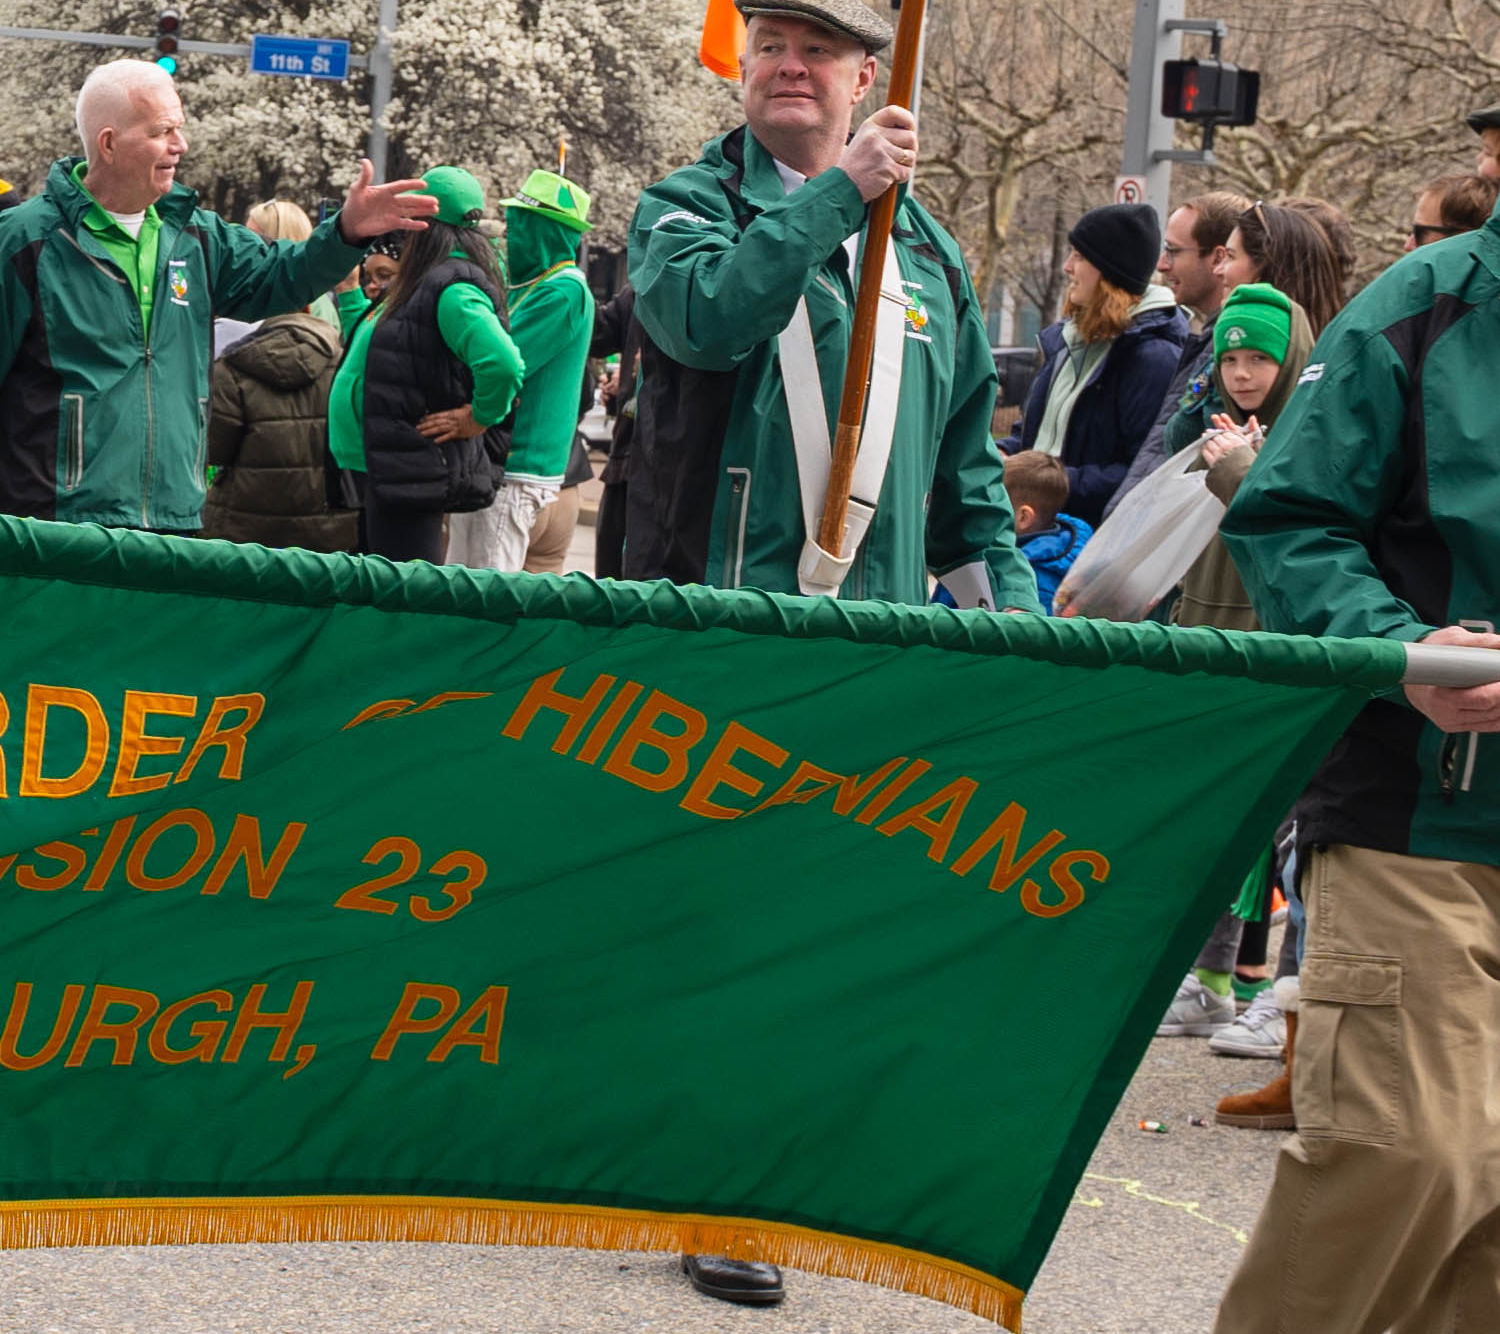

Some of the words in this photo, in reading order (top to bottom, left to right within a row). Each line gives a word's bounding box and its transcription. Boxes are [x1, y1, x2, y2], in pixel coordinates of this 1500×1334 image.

[269, 53, 304, 71] 11th
[311, 56, 331, 75] St
[500, 666, 1112, 921] HIBERNIANS
[334, 834, 489, 924] 23
[371, 981, 511, 1066] PA
